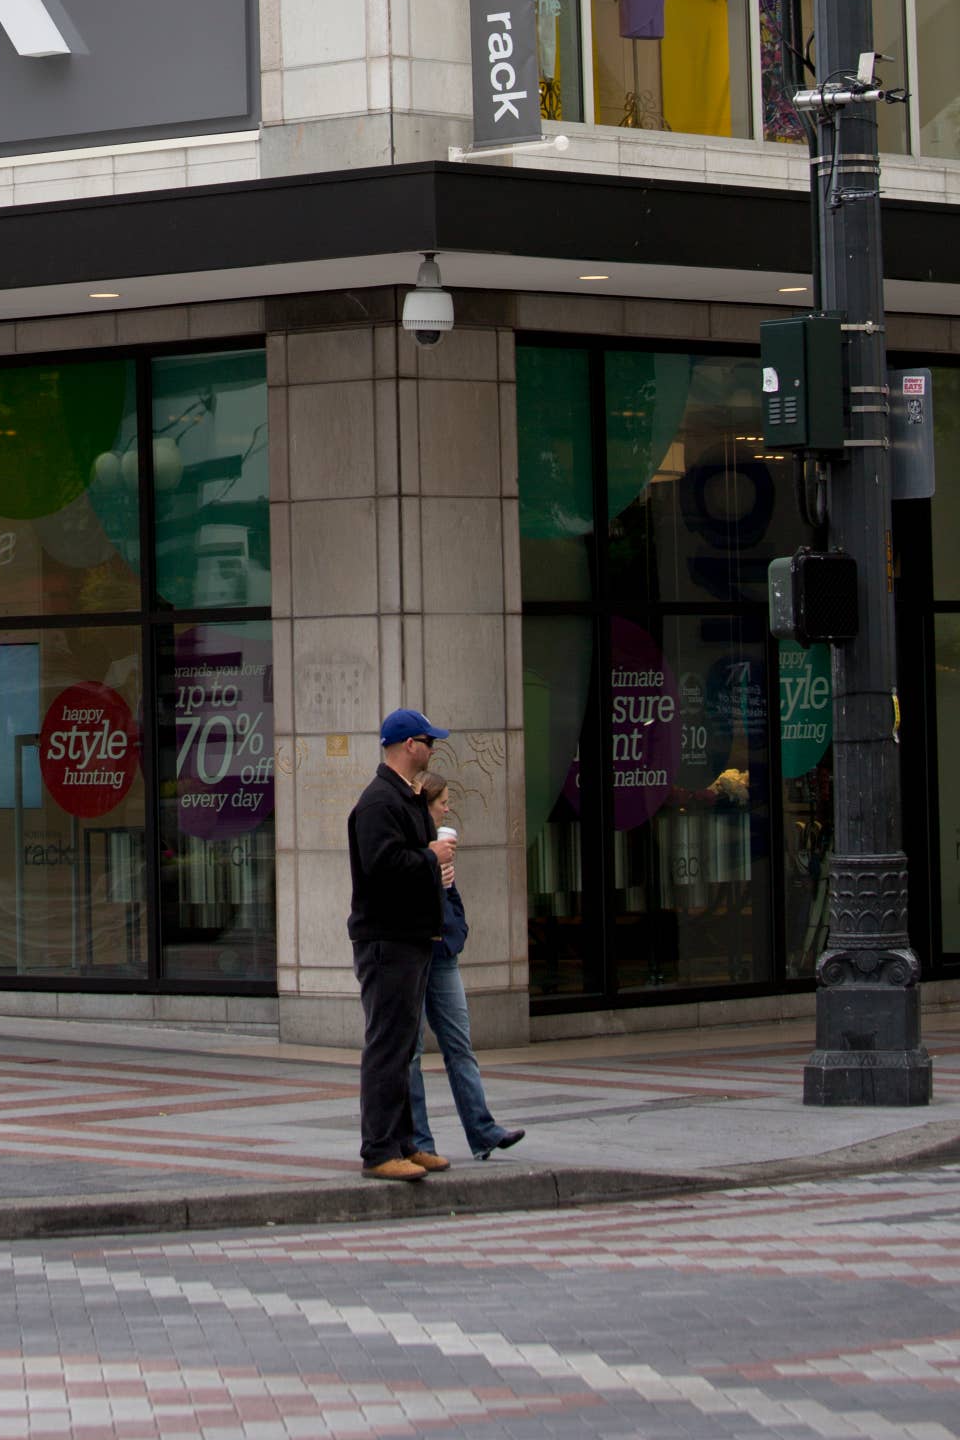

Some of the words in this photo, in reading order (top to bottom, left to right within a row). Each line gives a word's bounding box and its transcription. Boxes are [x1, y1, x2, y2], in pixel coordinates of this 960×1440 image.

[487, 10, 528, 123] rack
[214, 664, 239, 679] you
[240, 661, 266, 677] love
[611, 665, 665, 688] timate
[209, 680, 239, 708] to
[779, 663, 830, 721] yle
[61, 704, 105, 725] happy
[611, 694, 676, 724] sure
[47, 718, 129, 770] style
[175, 711, 264, 785] 70%
[62, 765, 127, 790] hunting
[239, 757, 274, 785] off
[612, 764, 669, 788] nation
[181, 792, 229, 812] every
[231, 787, 265, 812] day
